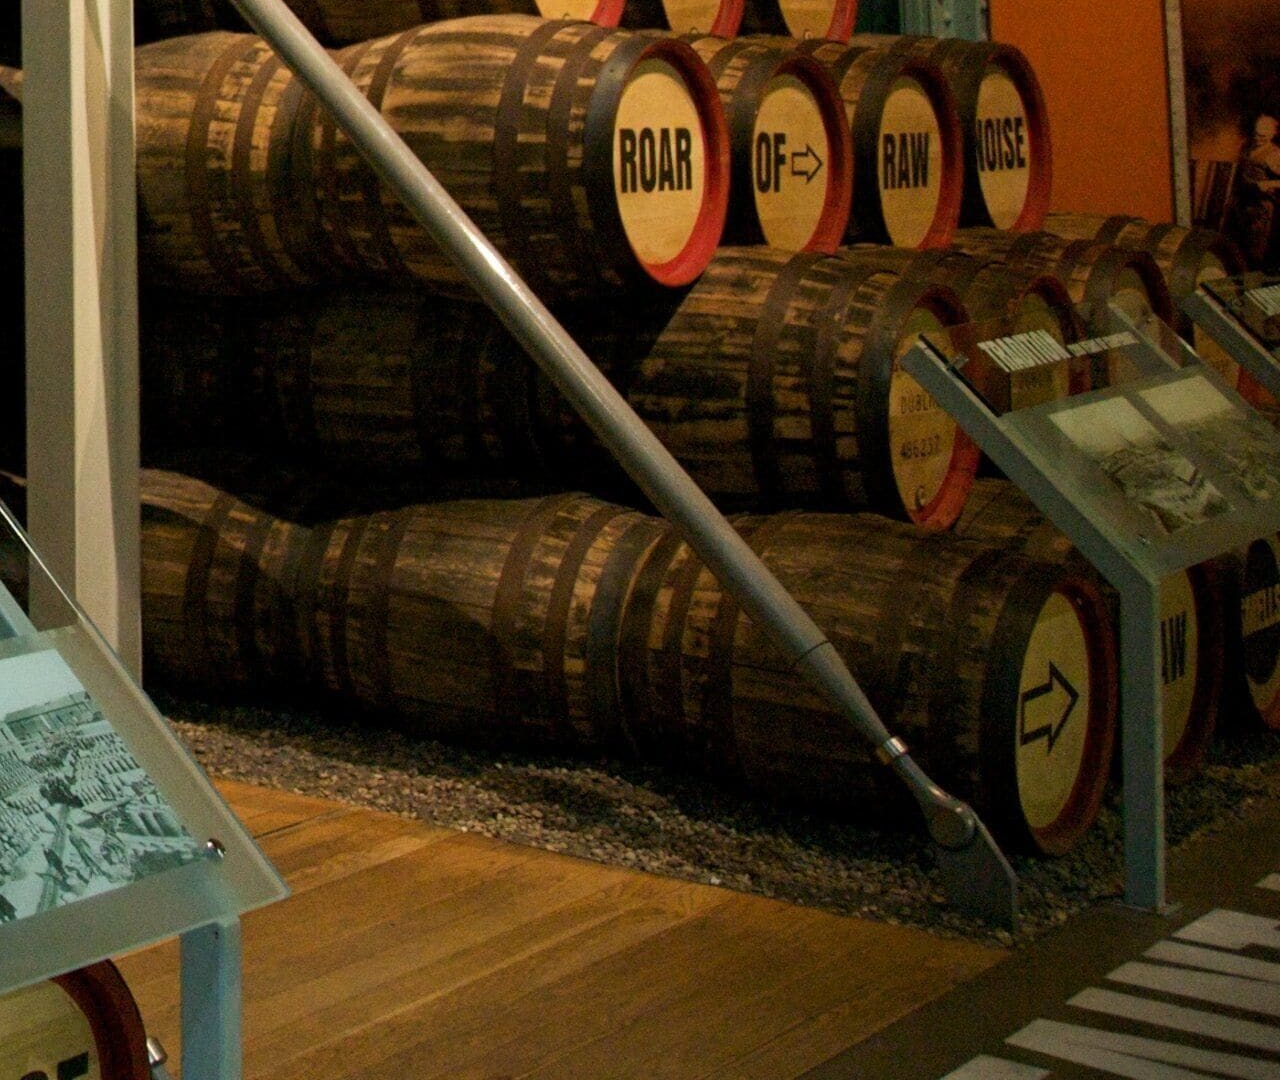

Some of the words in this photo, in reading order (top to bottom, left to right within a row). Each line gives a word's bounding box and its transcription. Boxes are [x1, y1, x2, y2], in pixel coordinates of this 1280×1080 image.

[620, 127, 693, 194] ROAR
[756, 132, 786, 194] OF
[882, 133, 930, 189] RAW
[977, 116, 1026, 172] NOISE
[901, 394, 940, 414] DUBLI
